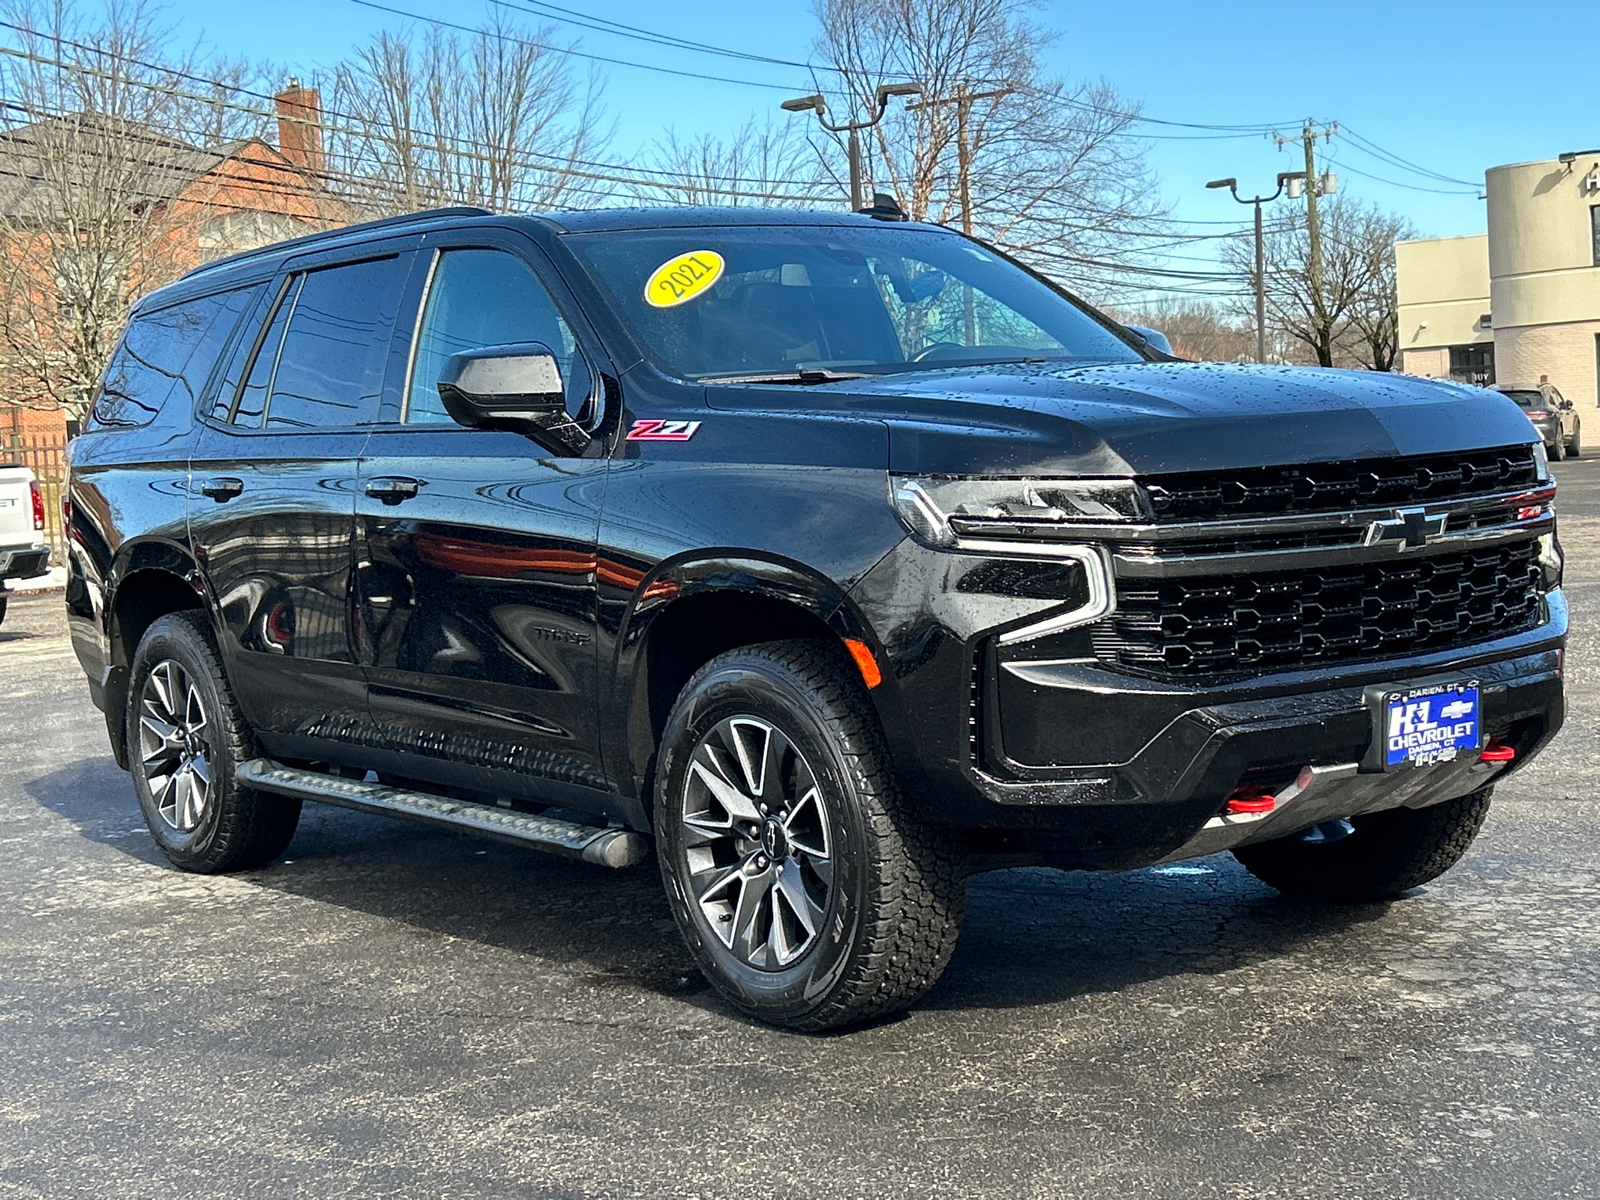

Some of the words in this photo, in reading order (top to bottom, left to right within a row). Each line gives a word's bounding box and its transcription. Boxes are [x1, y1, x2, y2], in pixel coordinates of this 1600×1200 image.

[659, 256, 713, 298] 2021
[626, 419, 702, 441] Z71
[1389, 701, 1437, 737] H&L
[1389, 721, 1474, 751] CHEVROLET
